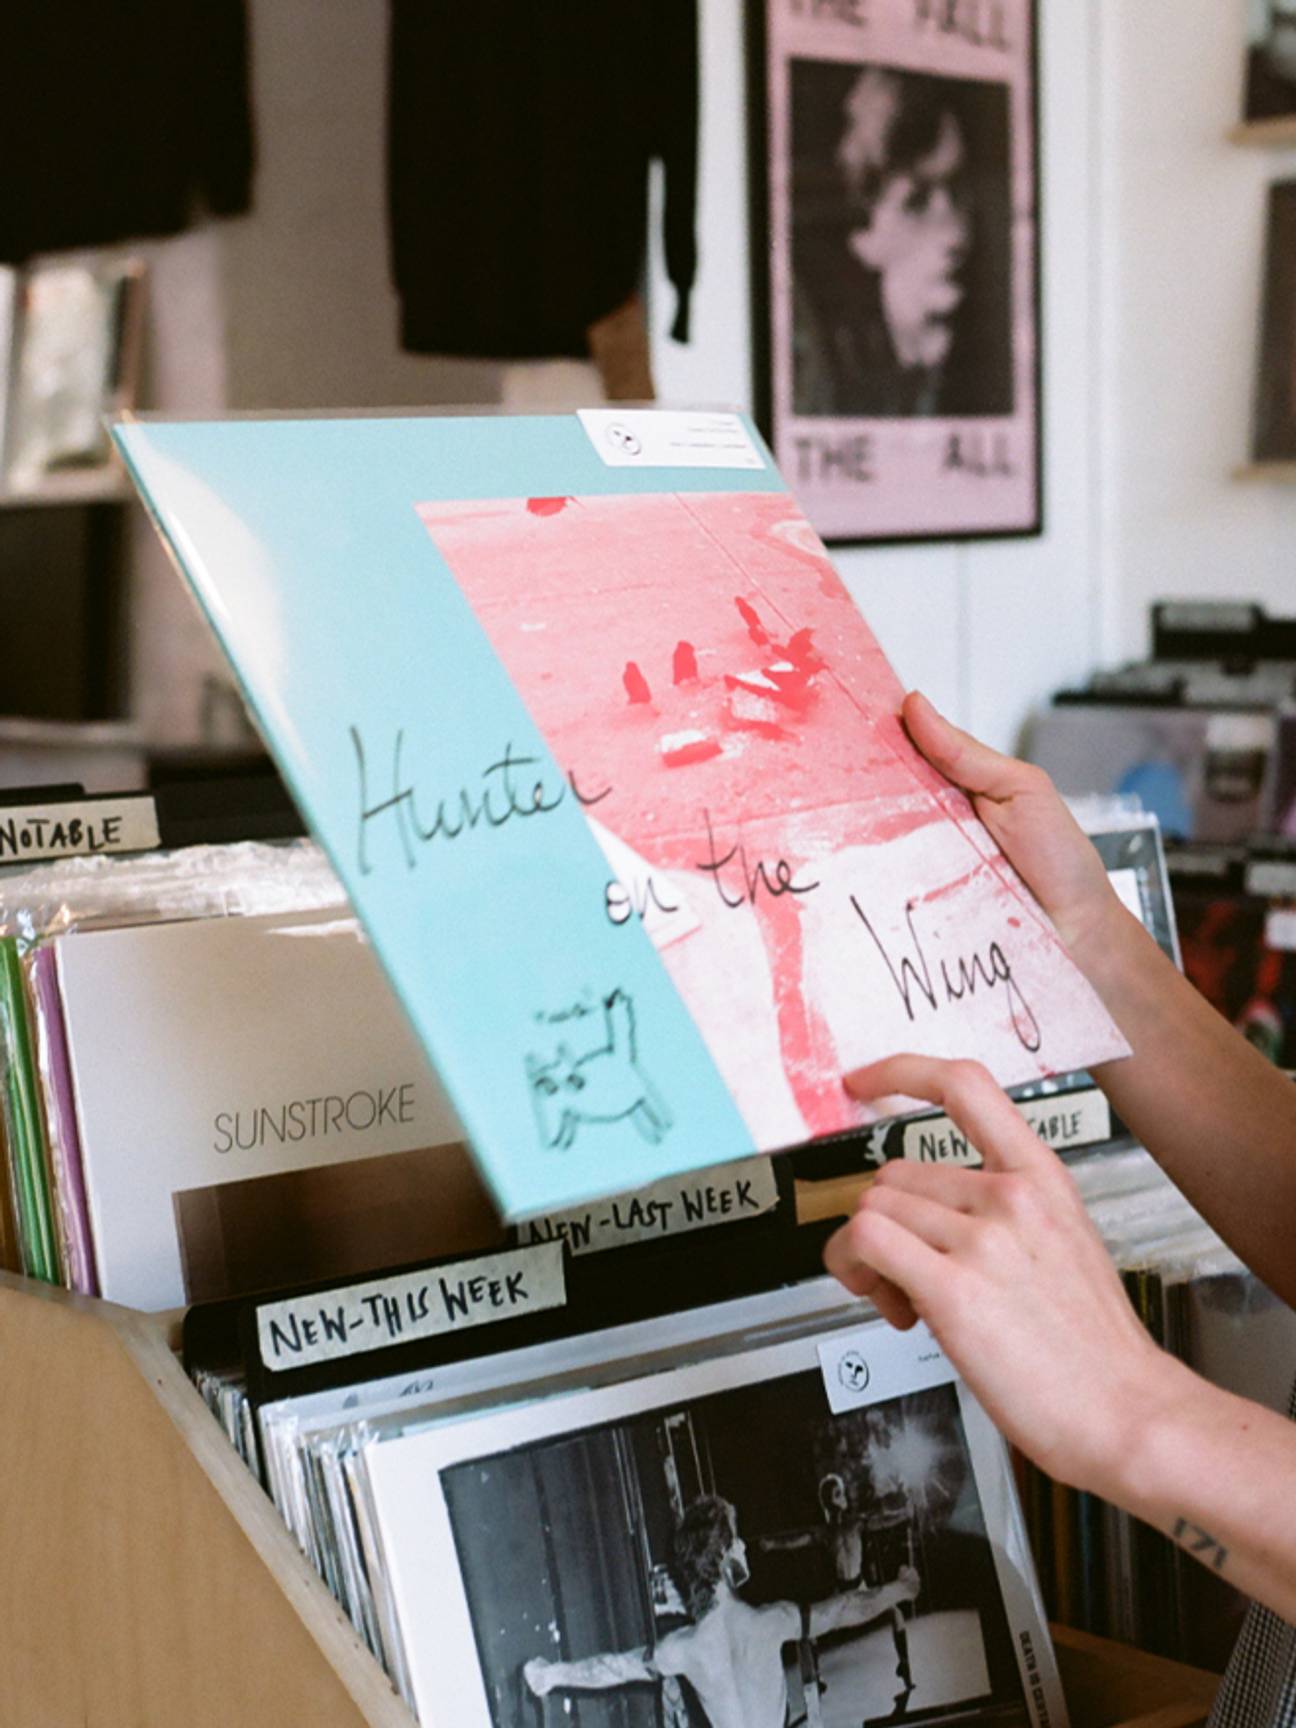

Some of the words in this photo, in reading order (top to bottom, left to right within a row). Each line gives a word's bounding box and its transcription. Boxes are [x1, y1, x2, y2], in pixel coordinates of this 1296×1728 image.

[0, 815, 123, 855] NOTABLE
[349, 724, 613, 876] Hunter
[604, 877, 679, 925] on
[695, 807, 821, 909] the
[849, 894, 1041, 1054] Wing
[213, 1083, 415, 1154] SUNSTROKE
[680, 1179, 759, 1222] WEEK
[439, 1271, 529, 1322] WEEK
